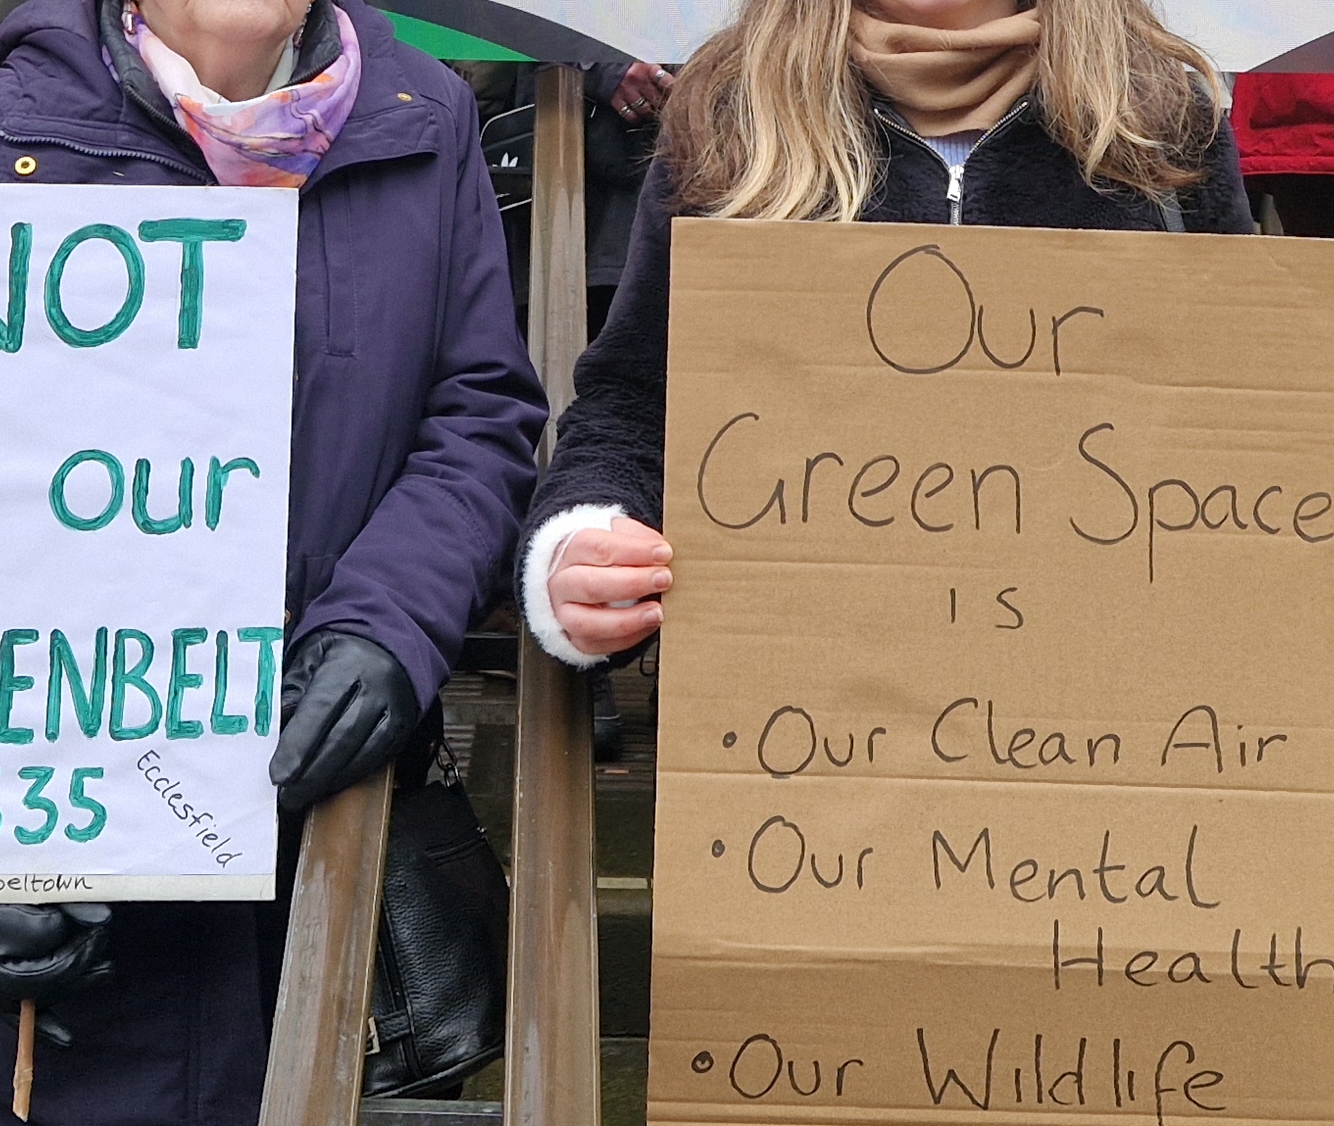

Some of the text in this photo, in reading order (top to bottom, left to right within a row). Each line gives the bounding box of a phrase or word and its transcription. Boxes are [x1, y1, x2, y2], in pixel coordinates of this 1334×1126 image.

[867, 244, 1104, 376] Our
[49, 448, 261, 534] our
[697, 411, 1334, 584] Green Space
[757, 697, 1288, 779] Our Clean Air
[135, 749, 245, 870] Ecclesfield
[747, 815, 1222, 908] Our Mental
[729, 1027, 1227, 1126] Our Wildlife
